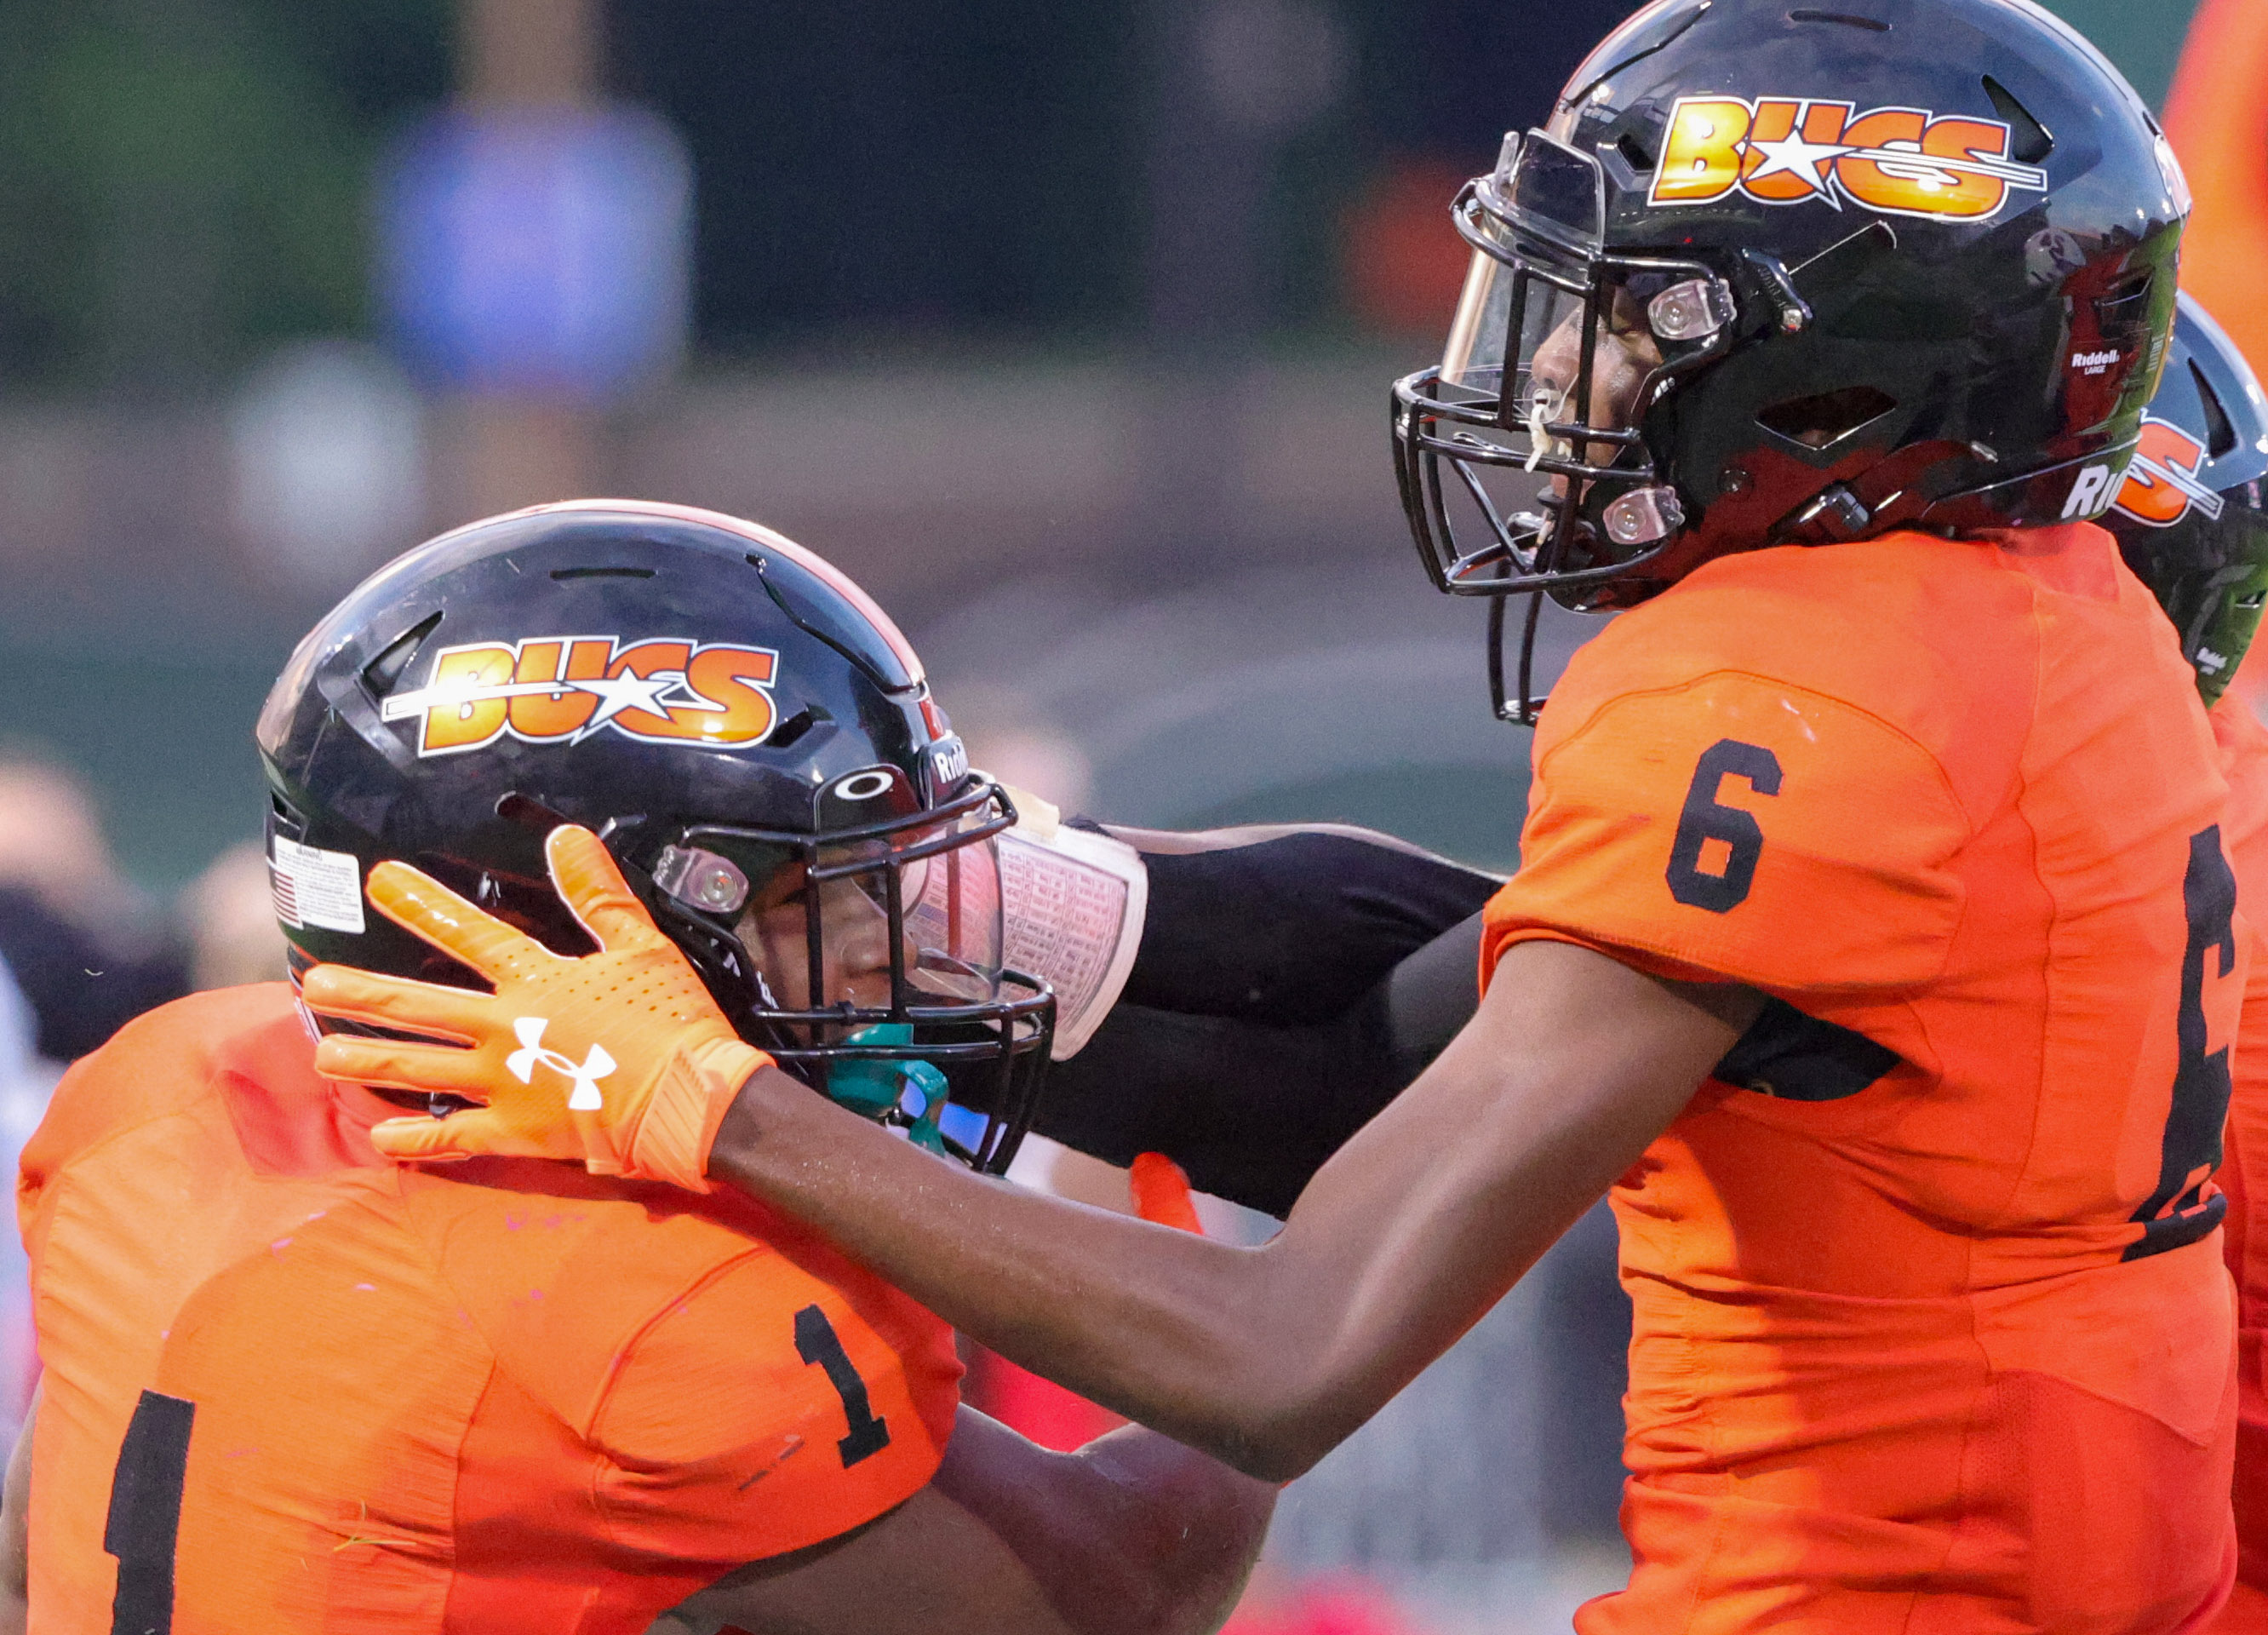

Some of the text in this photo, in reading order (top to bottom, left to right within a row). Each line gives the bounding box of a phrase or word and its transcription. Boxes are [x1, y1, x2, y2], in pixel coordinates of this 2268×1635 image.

[1648, 95, 2013, 222] BUCS
[2071, 349, 2116, 368] Riddell
[2084, 365, 2106, 376] LARGE
[418, 635, 780, 758] BUCS
[1665, 738, 1784, 914] 6
[793, 1304, 891, 1470] 1
[104, 1389, 197, 1635] 1
